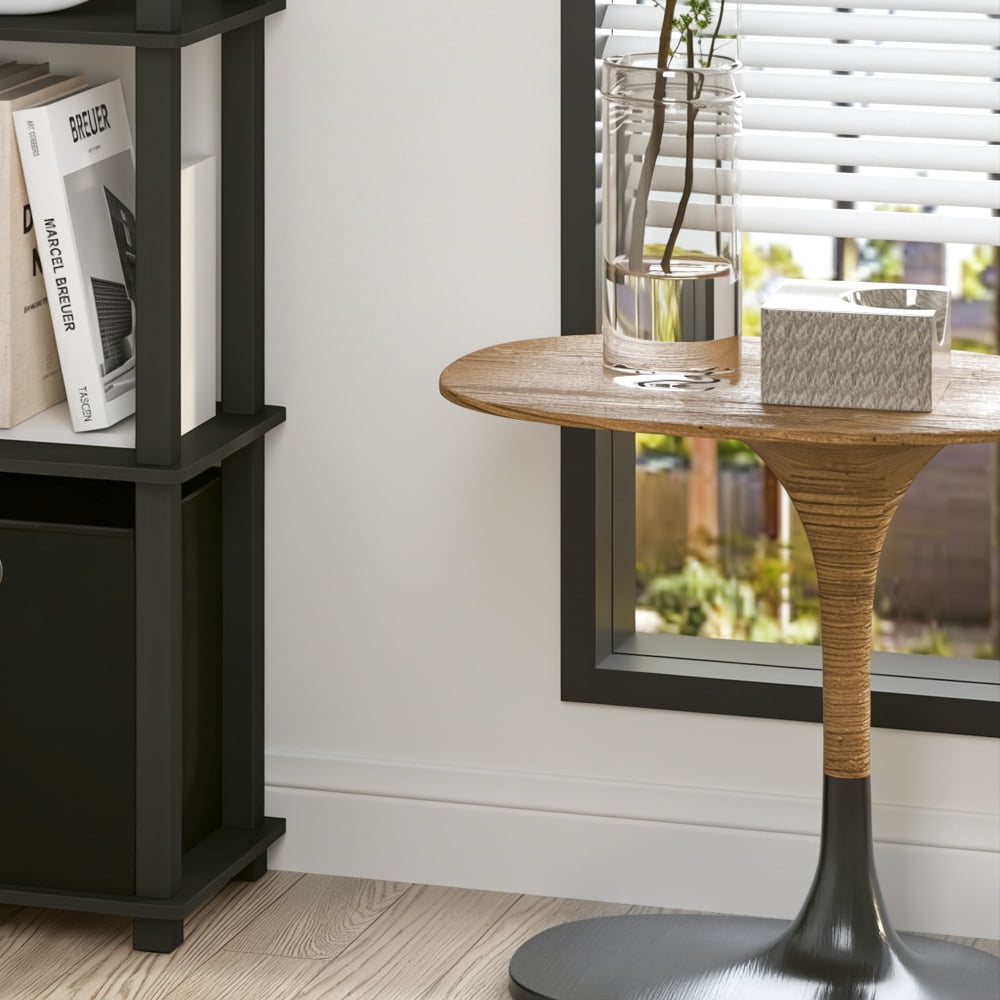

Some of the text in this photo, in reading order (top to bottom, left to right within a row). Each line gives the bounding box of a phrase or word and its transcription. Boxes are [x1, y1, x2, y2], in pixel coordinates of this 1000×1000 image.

[68, 103, 111, 143] BREUER
[44, 218, 76, 332] MARCEL BREUER
